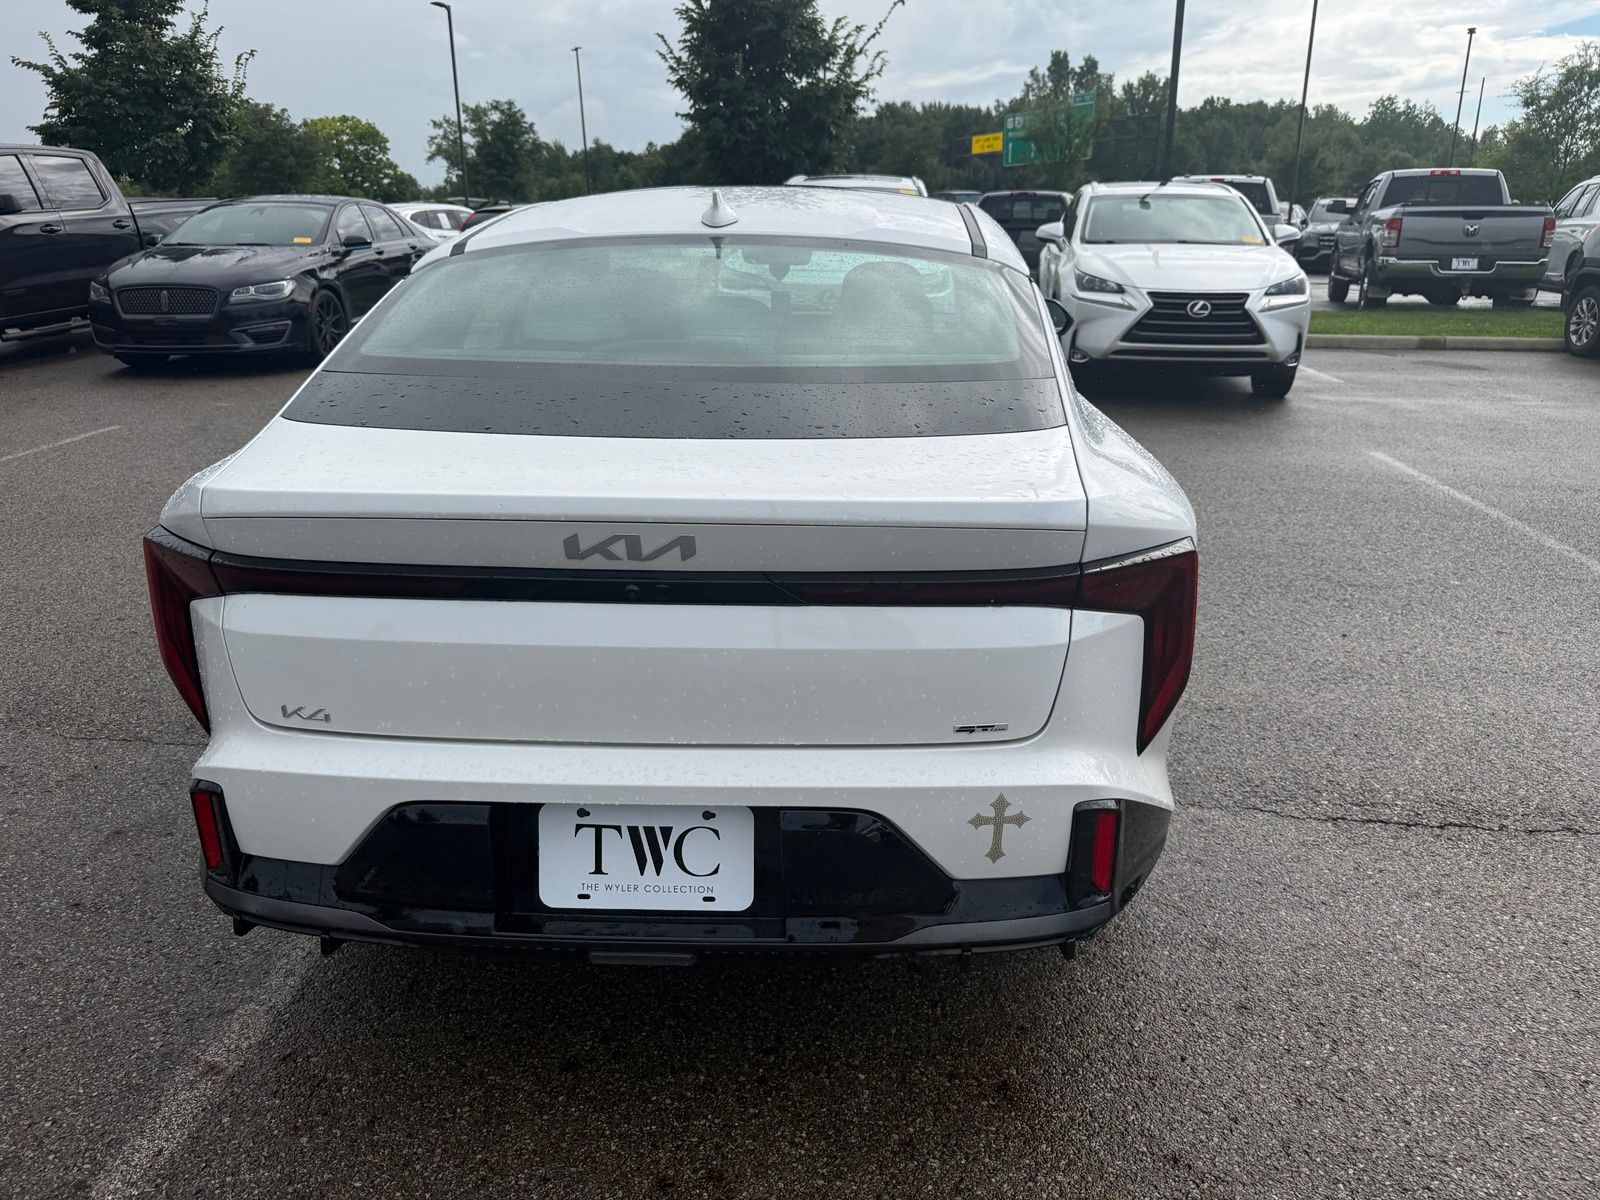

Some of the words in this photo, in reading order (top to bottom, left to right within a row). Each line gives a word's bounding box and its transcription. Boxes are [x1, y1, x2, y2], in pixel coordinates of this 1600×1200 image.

[563, 532, 697, 562] KIA
[281, 704, 331, 723] K4
[574, 823, 721, 877] TWC
[581, 882, 600, 892] THE
[604, 883, 639, 893] WYLER
[643, 884, 714, 894] COLLECTION
